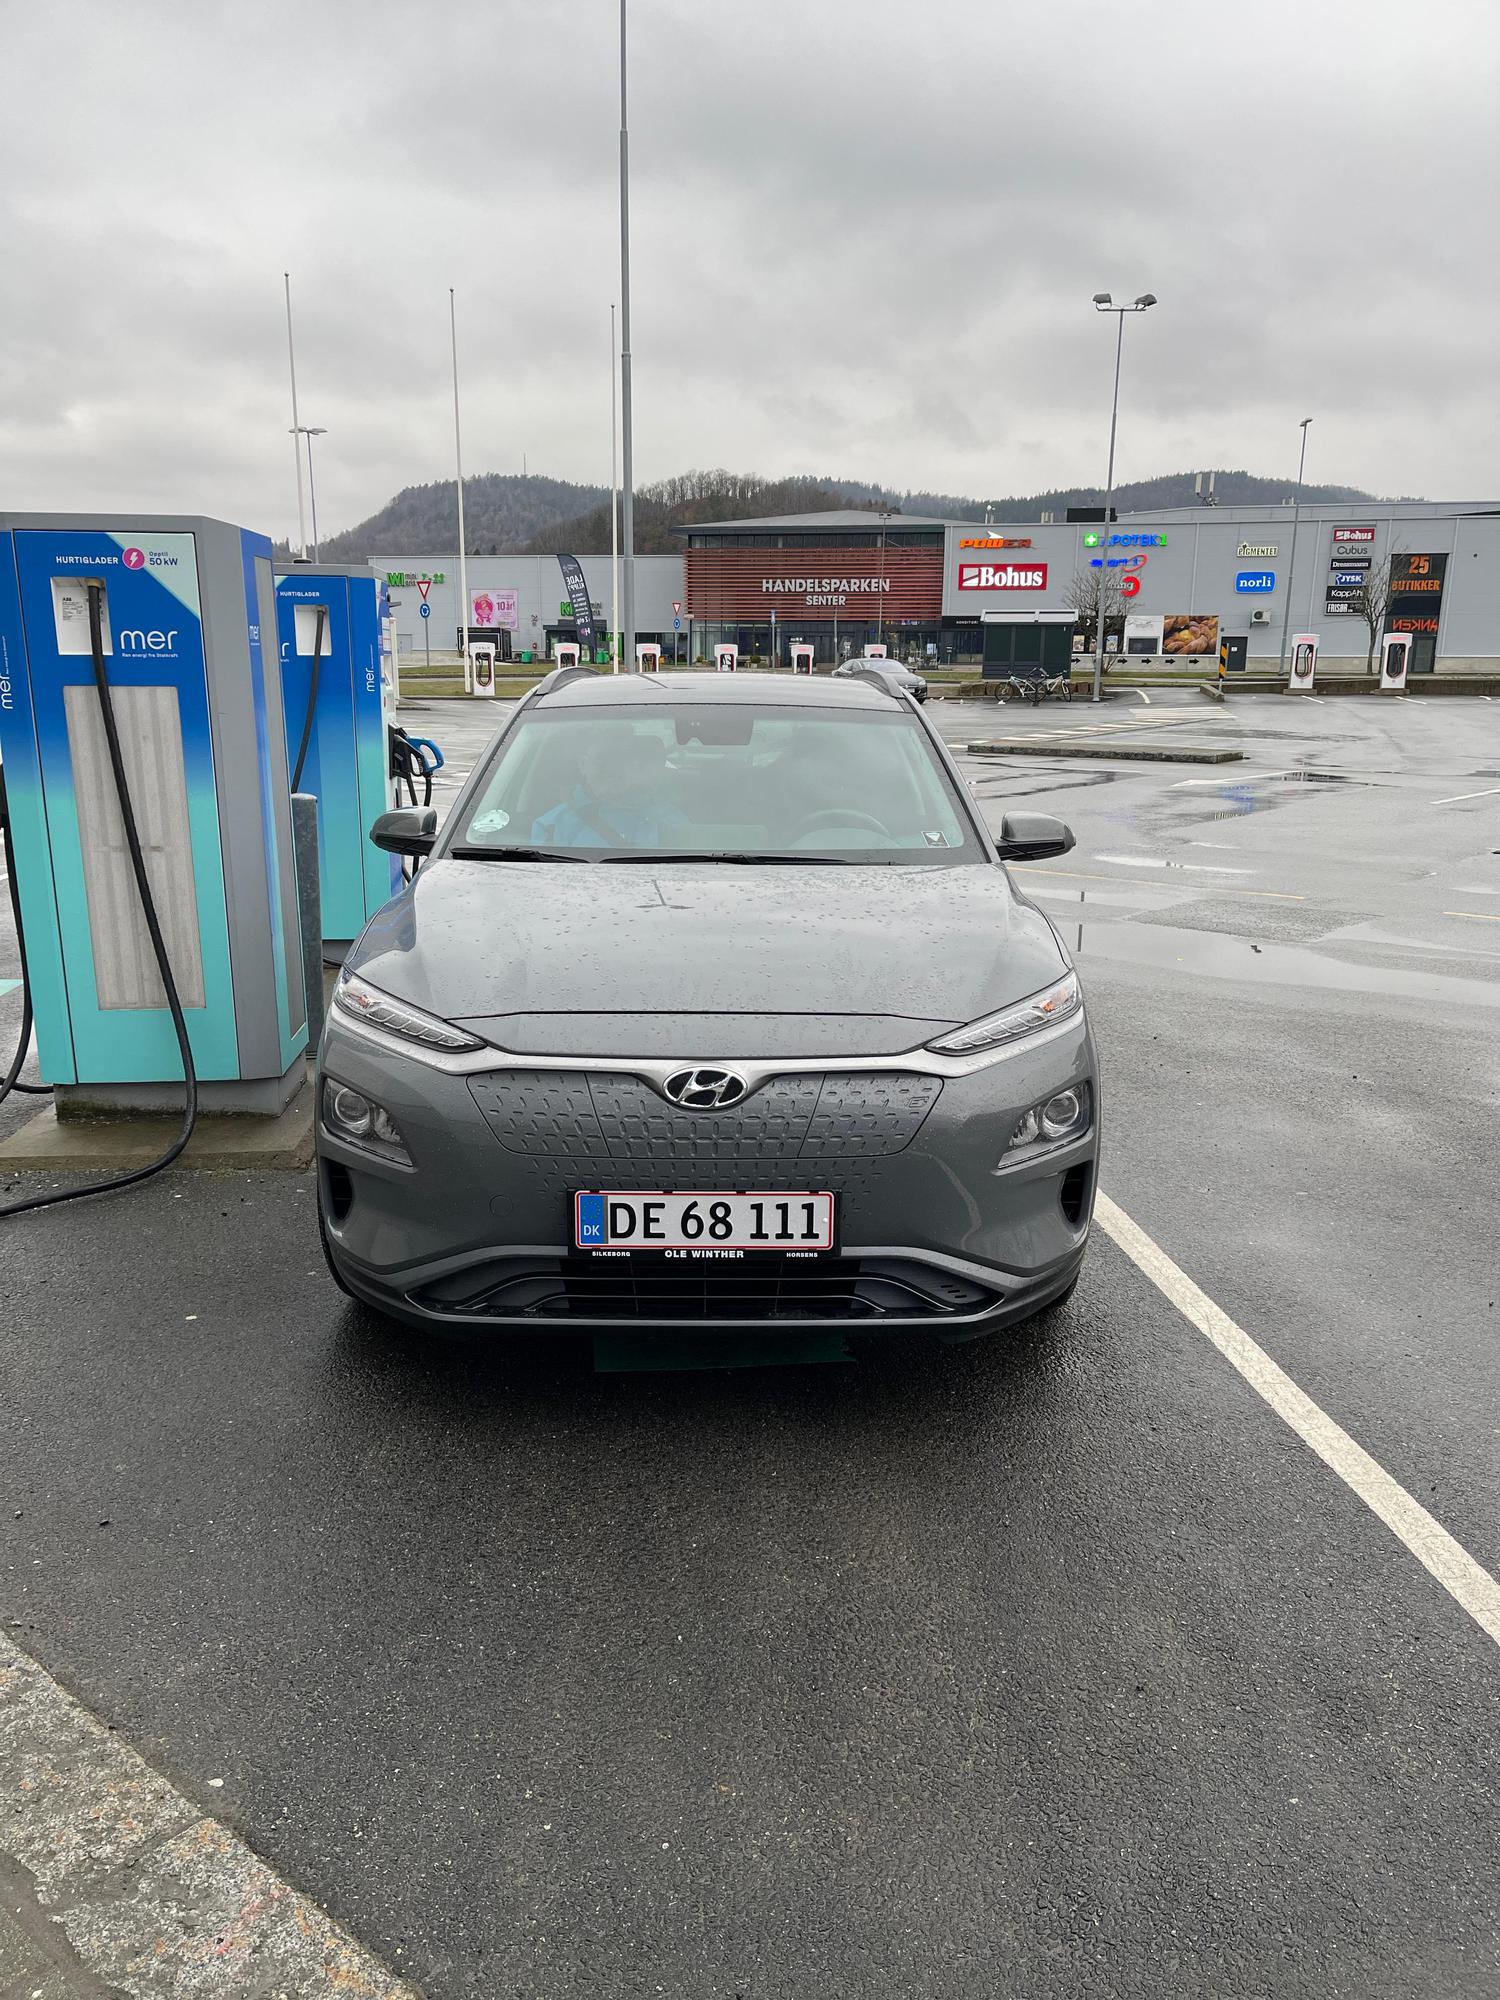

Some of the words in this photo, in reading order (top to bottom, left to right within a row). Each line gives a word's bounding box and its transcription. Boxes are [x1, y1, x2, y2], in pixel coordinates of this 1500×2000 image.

[1343, 530, 1373, 540] Bohus
[959, 538, 1032, 549] POWER
[1237, 543, 1278, 557] PIGMENTET
[1336, 545, 1368, 555] Cubus
[55, 555, 119, 564] HURTIGLADER
[149, 557, 161, 566] 50
[163, 558, 178, 566] kW
[1408, 555, 1431, 574] 25
[387, 572, 405, 587] WI
[979, 566, 1043, 587] Bohus
[1239, 575, 1272, 587] norli
[1340, 574, 1362, 582] JYSK
[762, 578, 890, 592] HANDELSPARKEN
[1391, 580, 1441, 591] BUTIKKER
[805, 595, 846, 606] SENTER
[120, 630, 178, 650] mer
[365, 667, 376, 692] mer
[0, 673, 14, 710] mer
[609, 1202, 666, 1239] DE
[680, 1200, 733, 1240] 68
[749, 1202, 820, 1239] 111
[583, 1225, 600, 1236] DK
[664, 1249, 687, 1258] OLE
[691, 1249, 744, 1258] WINTHER
